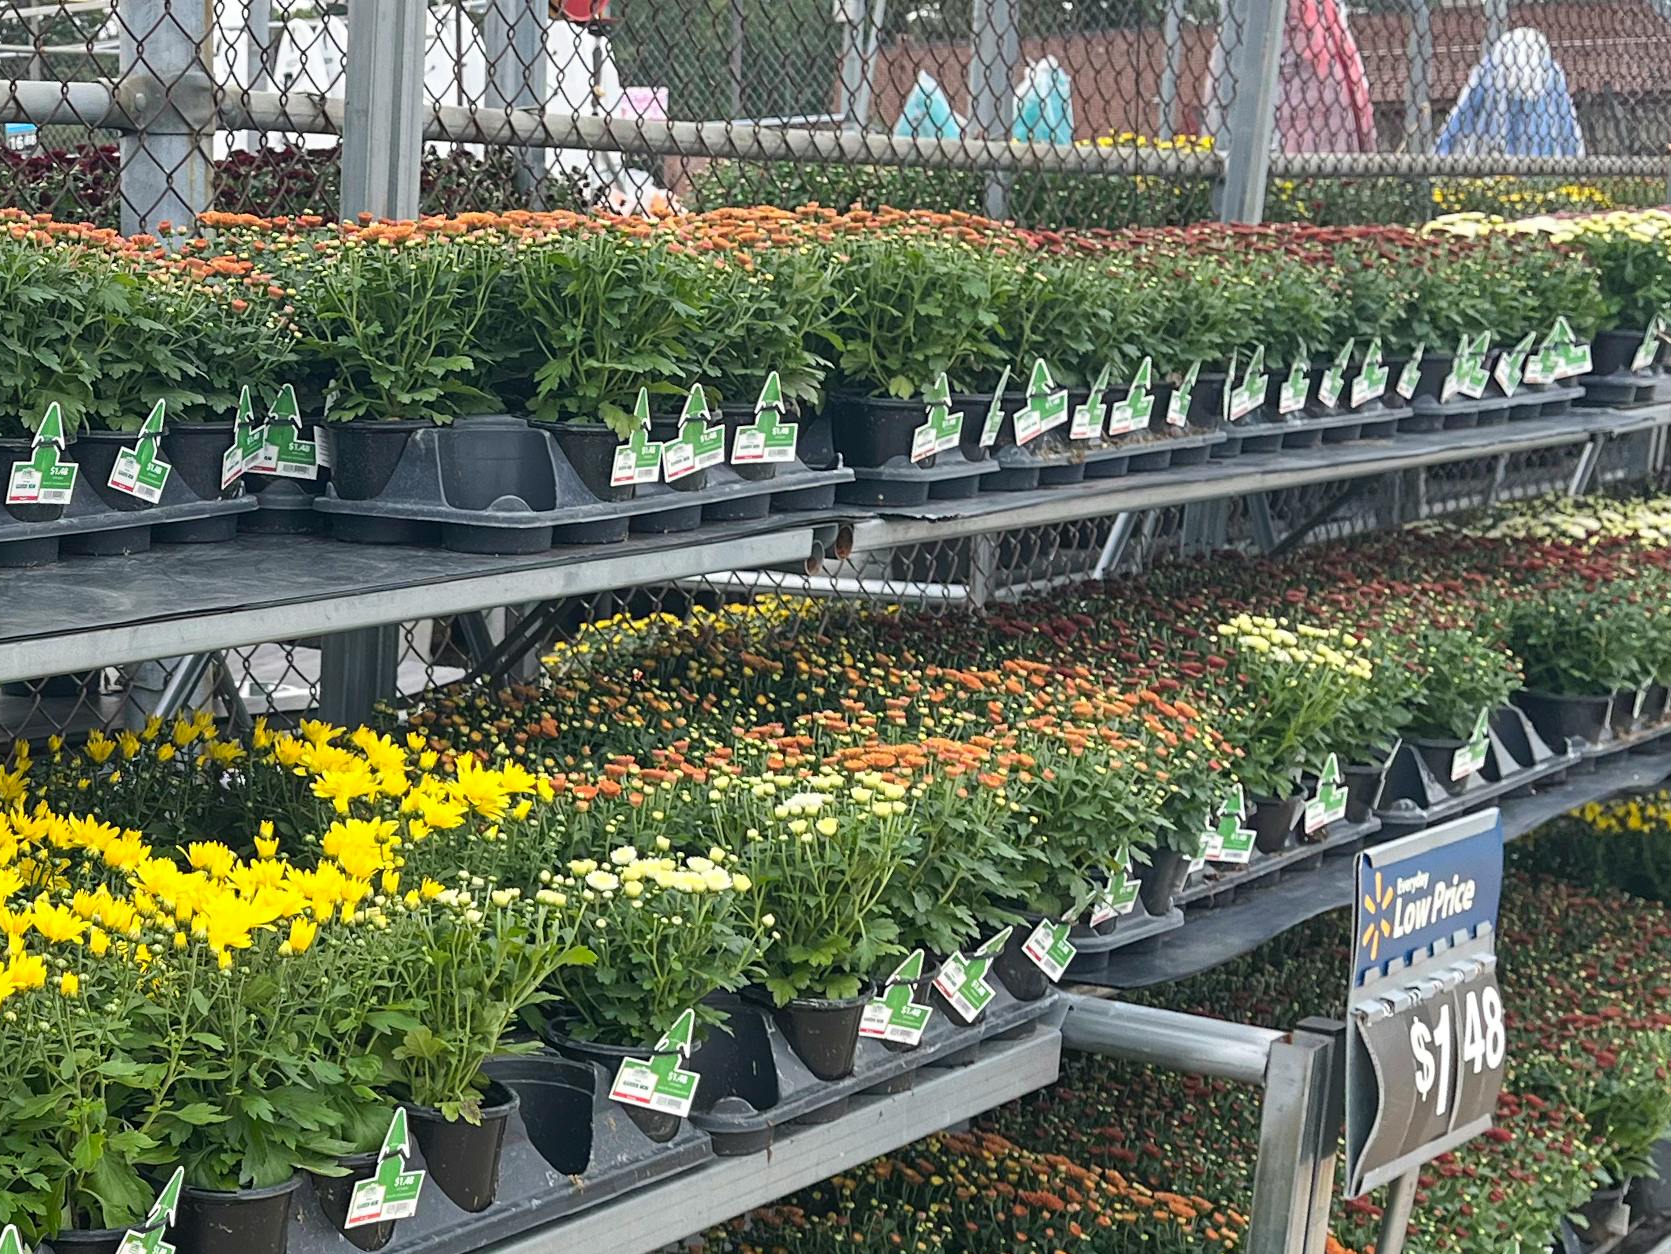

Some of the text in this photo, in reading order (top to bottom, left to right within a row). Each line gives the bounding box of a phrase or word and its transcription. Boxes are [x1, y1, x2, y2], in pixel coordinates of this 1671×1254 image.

[50, 466, 68, 475] $1.48
[1397, 870, 1429, 895] Everyday
[1393, 874, 1475, 938] Low Price
[668, 1072, 689, 1084] $1.48
[394, 1176, 415, 1187] $1.48
